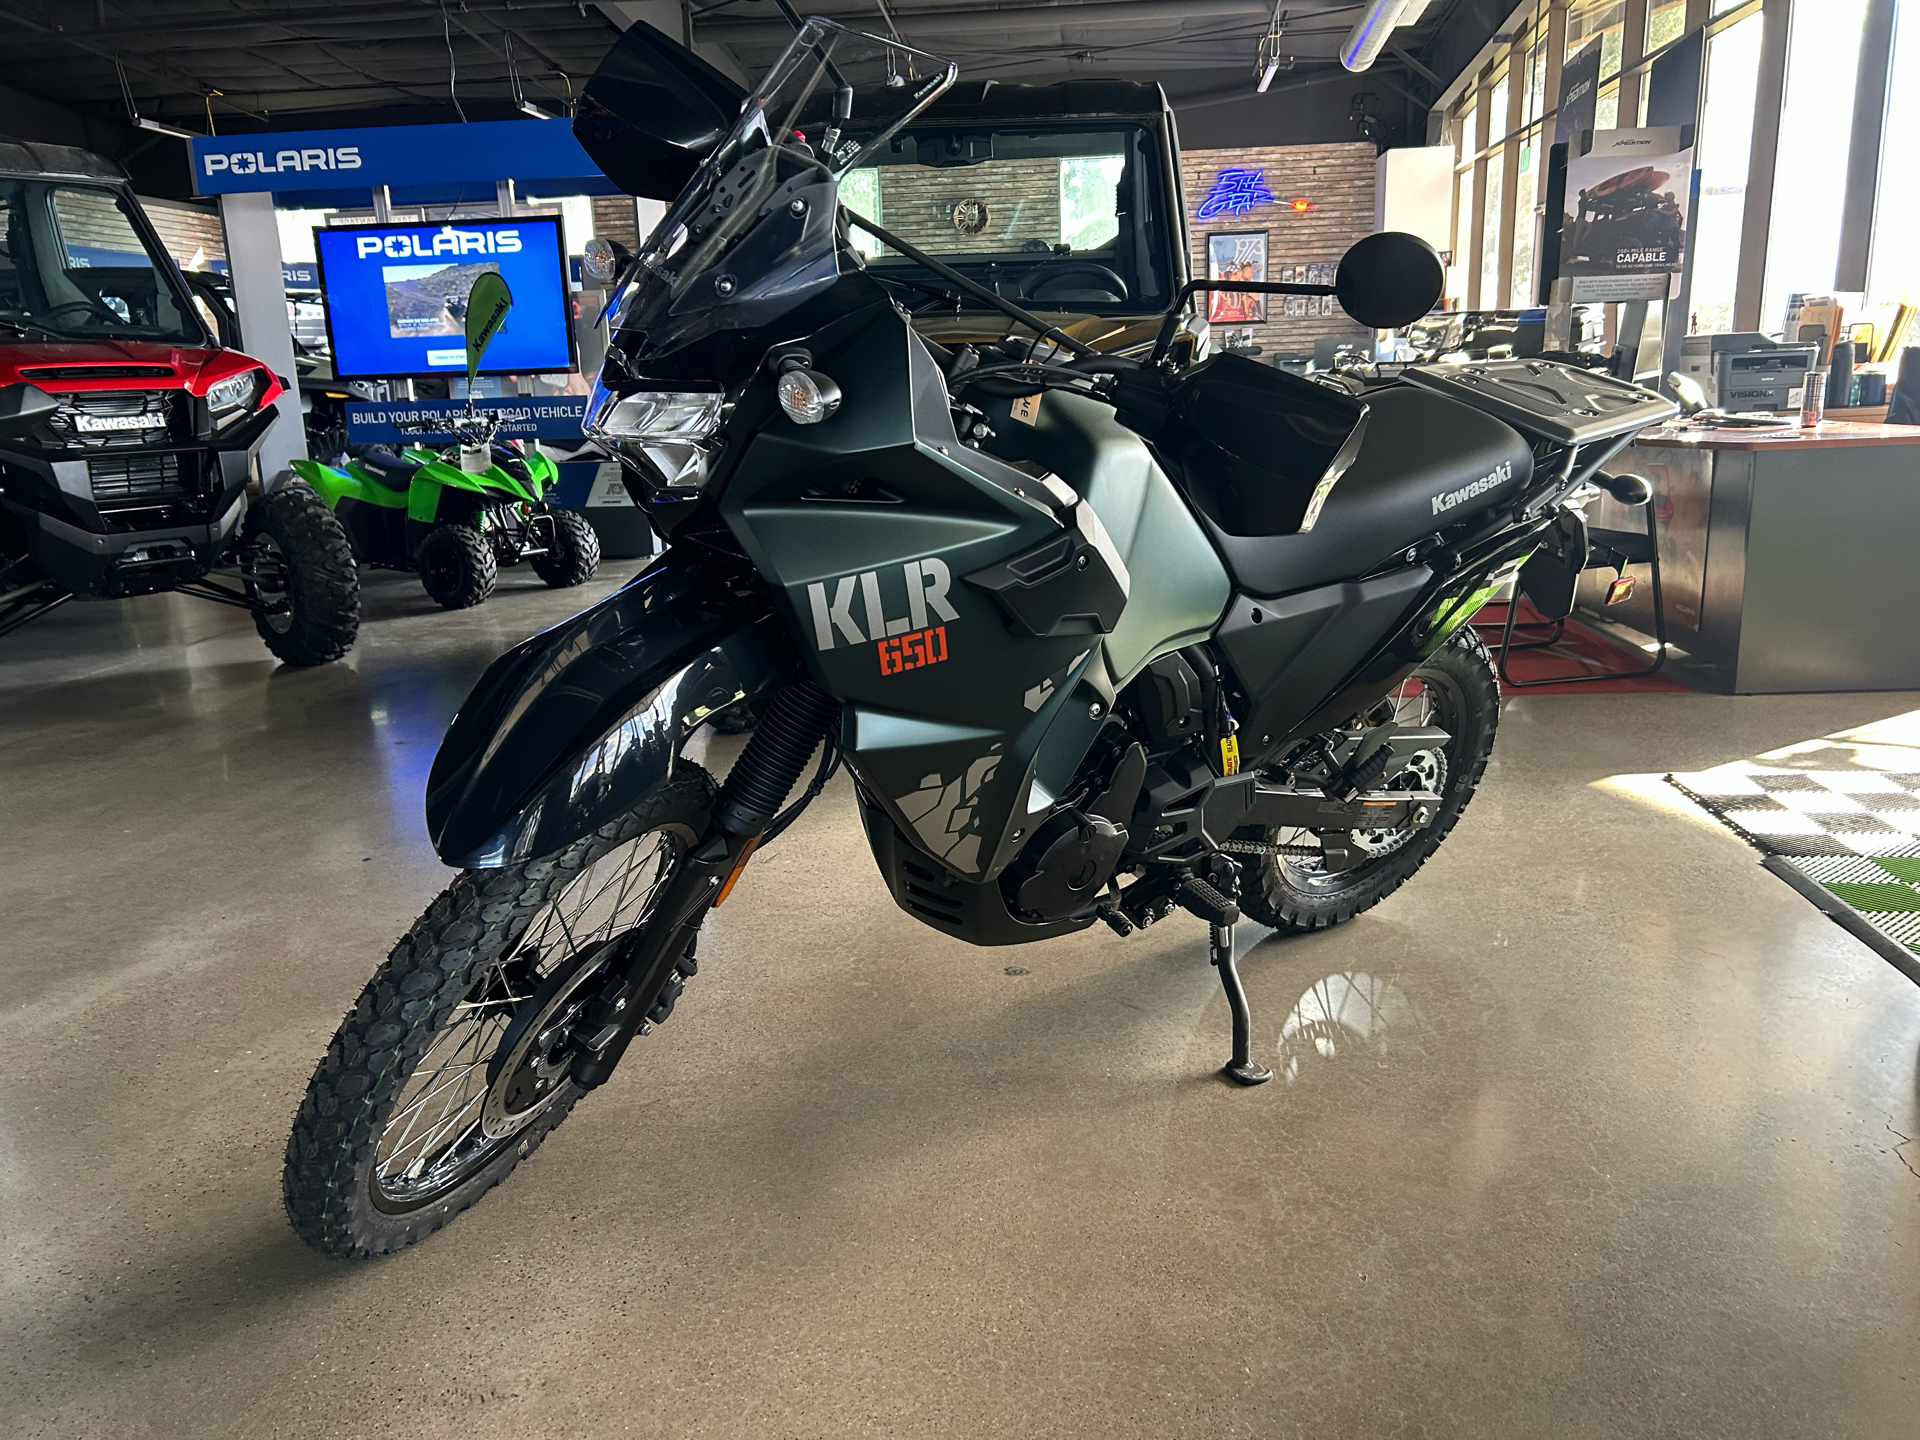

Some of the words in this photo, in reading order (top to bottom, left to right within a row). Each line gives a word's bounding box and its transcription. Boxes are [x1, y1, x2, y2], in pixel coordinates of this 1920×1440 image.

[203, 147, 362, 176] POLARIS
[1198, 189, 1273, 218] GEAR
[356, 230, 523, 259] POLARIS
[1616, 252, 1667, 263] CAPABLE
[472, 297, 510, 352] Kawasaki
[74, 412, 167, 432] Kawasaki
[352, 412, 386, 425] BUILD
[388, 410, 419, 423] YOUR
[533, 405, 583, 418] VEHICLE
[503, 423, 538, 432] STARTED
[1431, 460, 1512, 516] Kawasaki
[807, 557, 961, 652] KLR
[877, 626, 948, 676] 650
